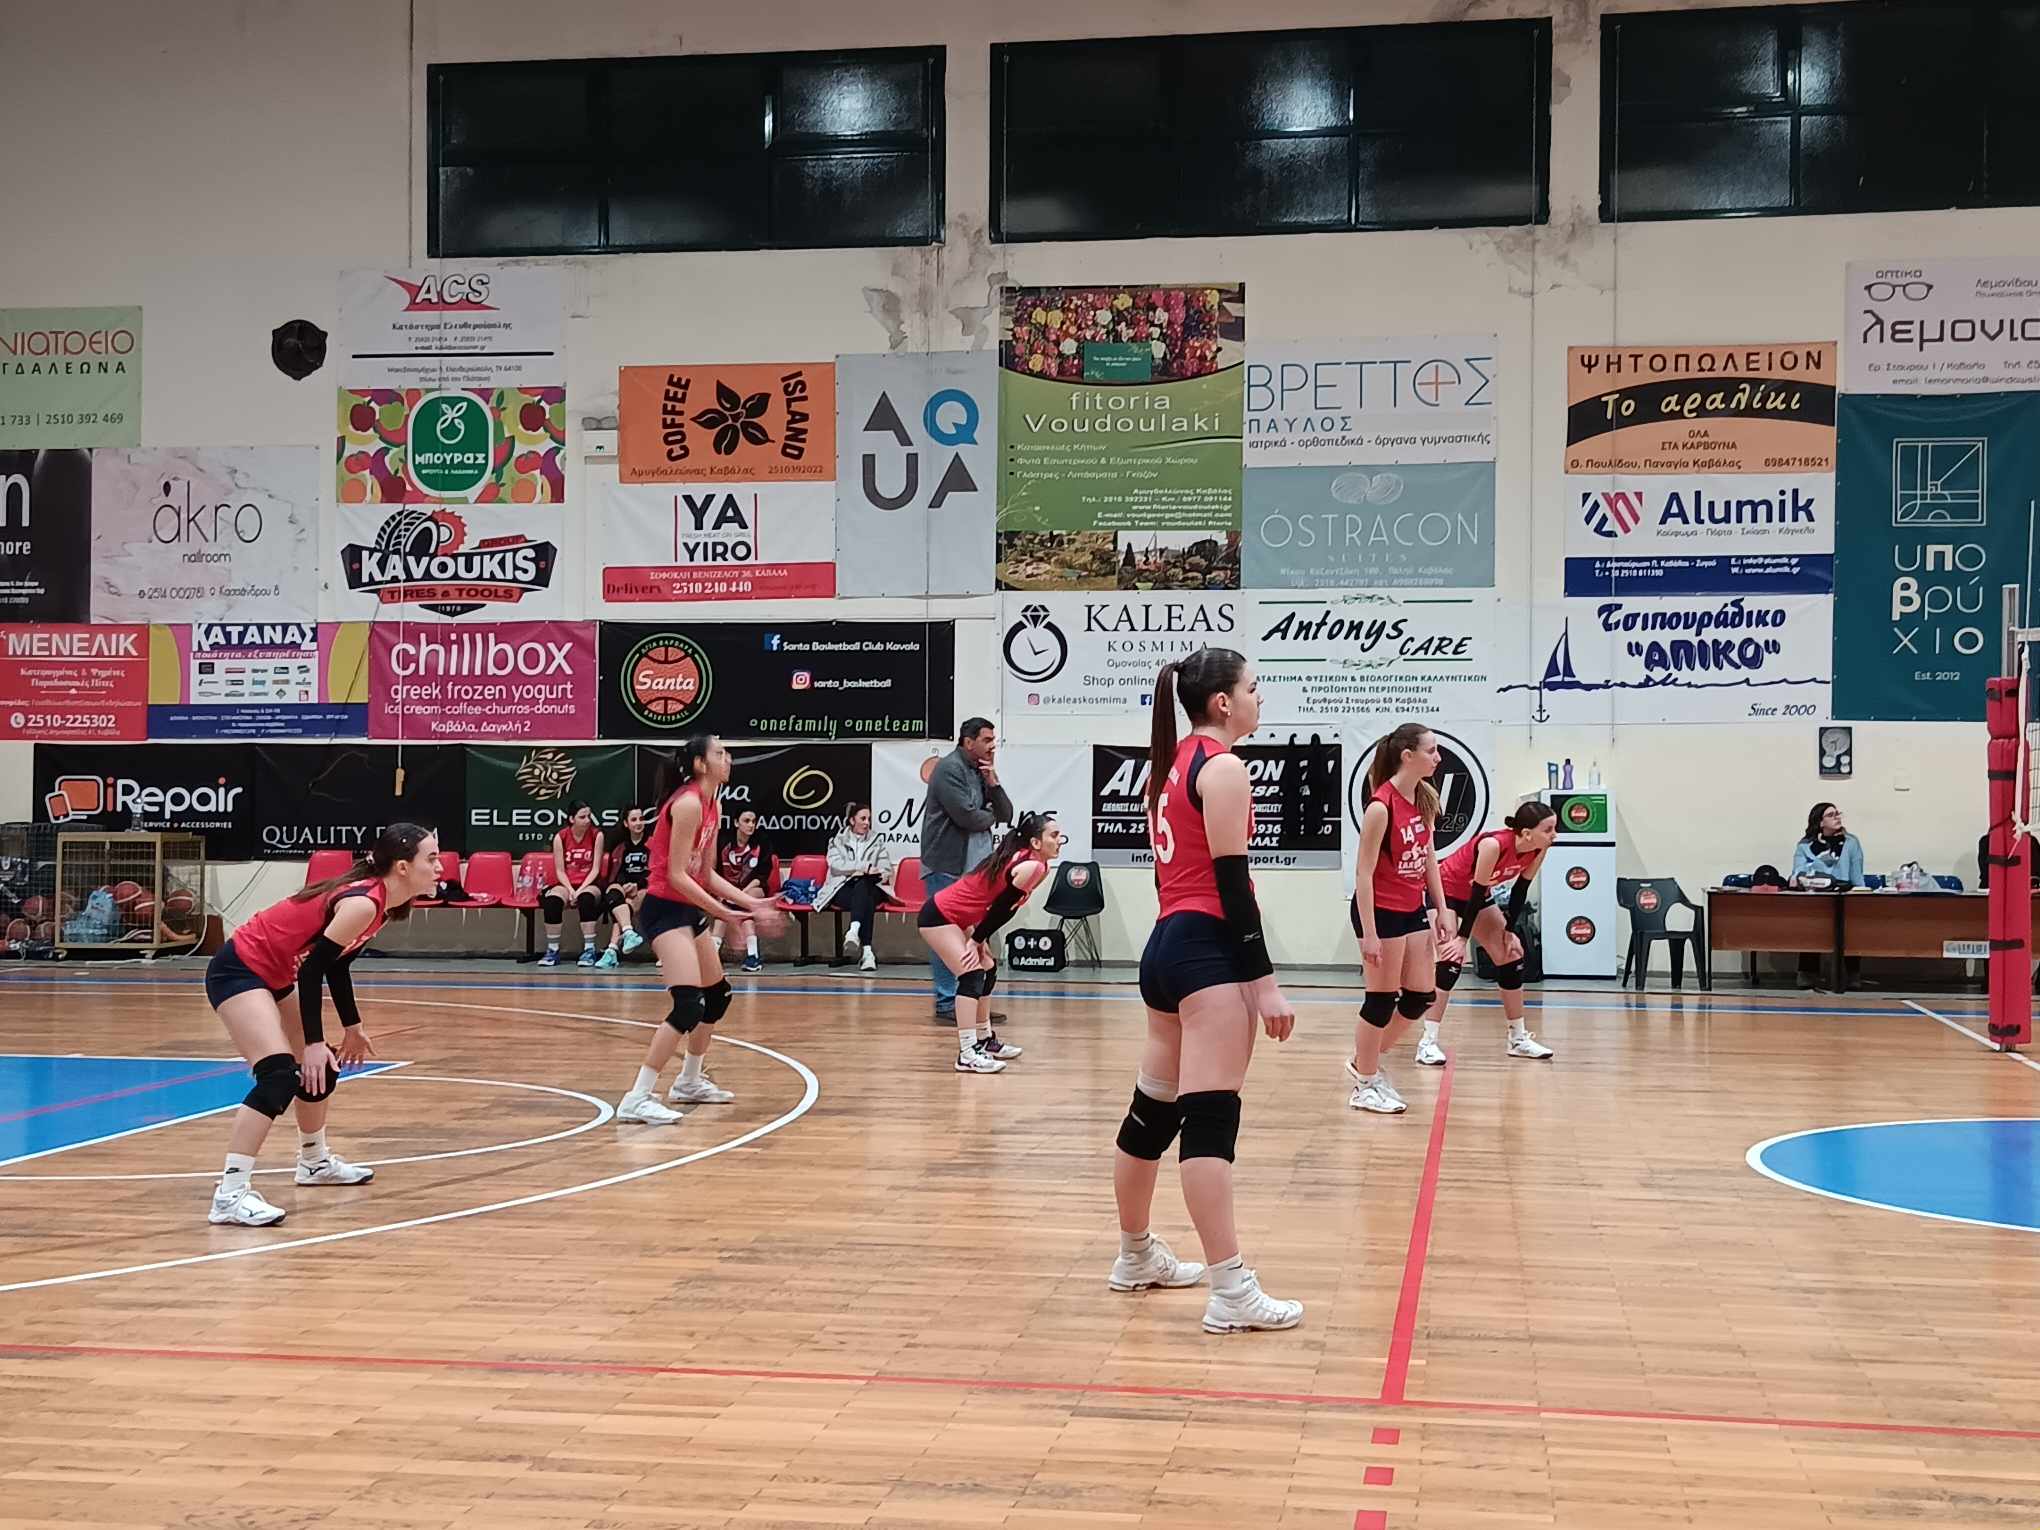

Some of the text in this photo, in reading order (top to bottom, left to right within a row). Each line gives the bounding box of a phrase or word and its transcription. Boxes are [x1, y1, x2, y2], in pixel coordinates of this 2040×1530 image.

[415, 273, 490, 305] ACS
[1580, 350, 1822, 374] ΨΗΤΟΠΩΛΕΙΟΝ
[1247, 357, 1493, 412] ΒΡΕΤΤΟΣ
[1070, 391, 1170, 411] fitoria
[1601, 393, 1635, 420] Το
[11, 413, 124, 425] 733 2510 392 469
[662, 373, 691, 462] COFFEE
[780, 370, 810, 461] ISLAND
[1024, 412, 1220, 433] Voudoulaki
[1249, 416, 1352, 434] ΠΑΥΛΟΣ
[1688, 429, 1709, 439] ΟΛΑ
[1661, 440, 1737, 451] ΣΤΑ ΚΑΡΒΟΥΝΑ
[709, 465, 755, 477] Καβάλας
[1643, 458, 1689, 470] Παναγία
[1692, 457, 1742, 470] Καβάλας
[682, 493, 749, 531] YA
[1658, 488, 1816, 525] Alumik
[682, 539, 752, 563] YIRO
[361, 548, 537, 583] KAVOUKIS
[387, 587, 514, 600] TIRES TOOLS
[1084, 603, 1235, 633] KALEAS
[1598, 598, 1786, 636] Τσιπουράδικο
[193, 623, 317, 652] ΚΑΤΑΝΑΣ
[1261, 609, 1408, 653] Antonys
[8, 633, 139, 657] ΜΕΝΕΛΙΚ
[390, 633, 573, 676] chillbox
[783, 641, 810, 651] Santa
[862, 641, 884, 651] Club
[886, 641, 920, 651] Kavala
[1399, 636, 1473, 656] CARE
[635, 670, 695, 690] Santa
[1083, 675, 1154, 688] Shop online
[1305, 674, 1348, 683] ΦΥΣΙΚΩΝ
[1359, 673, 1418, 682] ΒΙΟΛΟΓΙΚΩΝ
[1420, 673, 1487, 682] ΚΑΛΛΥΝΤΙΚΩΝ
[1935, 671, 1960, 681] 2012
[390, 681, 573, 704] greek frozen yogurt
[1042, 694, 1128, 706] @kaleaskosmima
[1395, 696, 1428, 706] Καβάλα
[1748, 703, 1816, 717] Since 2000
[27, 714, 116, 728] 2510-225302
[480, 720, 522, 734] Δαγκλή
[523, 720, 532, 732] 2
[107, 777, 243, 820] iRepair
[180, 821, 233, 829] ACCESSORIES
[1096, 822, 1127, 834] ΤΗΛ.
[262, 826, 367, 849] QUALITY
[518, 833, 543, 841] ESTD
[1020, 956, 1055, 966] Admiral
